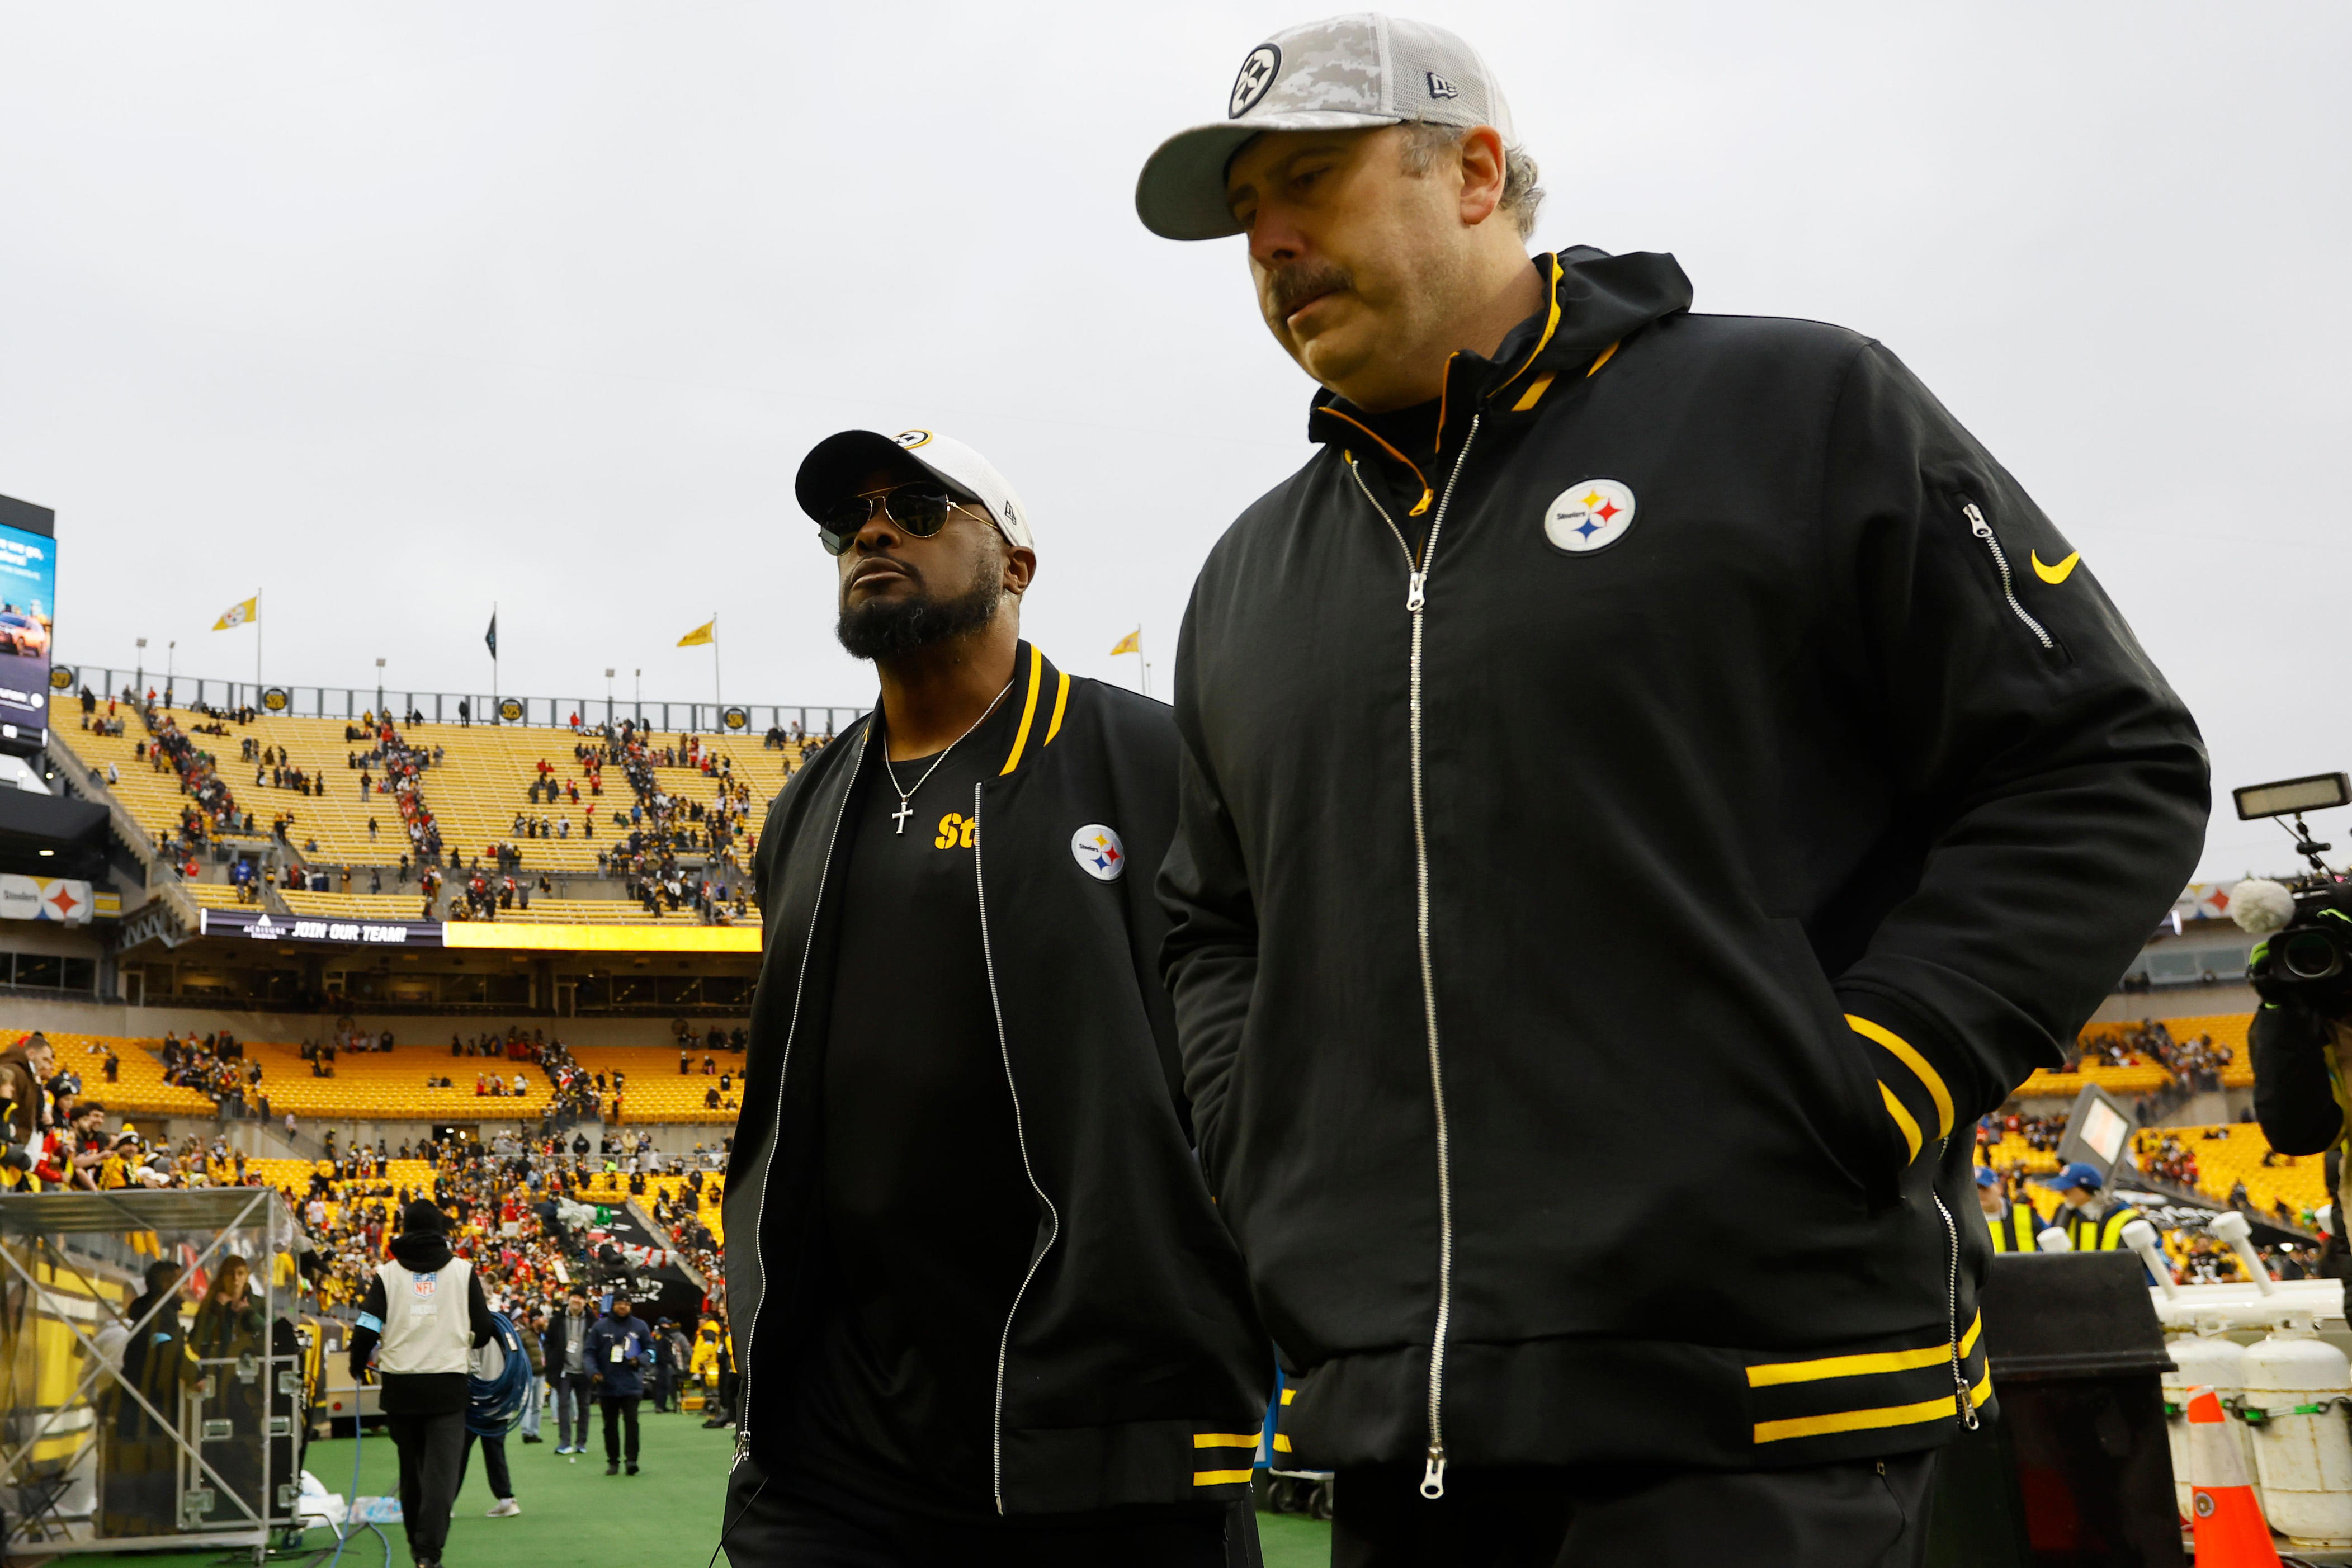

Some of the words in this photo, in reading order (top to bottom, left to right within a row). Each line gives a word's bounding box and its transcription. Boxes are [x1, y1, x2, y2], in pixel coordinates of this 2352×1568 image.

[934, 813, 976, 849] St
[291, 921, 327, 938] JOIN
[329, 923, 360, 941] OUR
[362, 925, 407, 942] TEAM!
[415, 1282, 436, 1295] NFL
